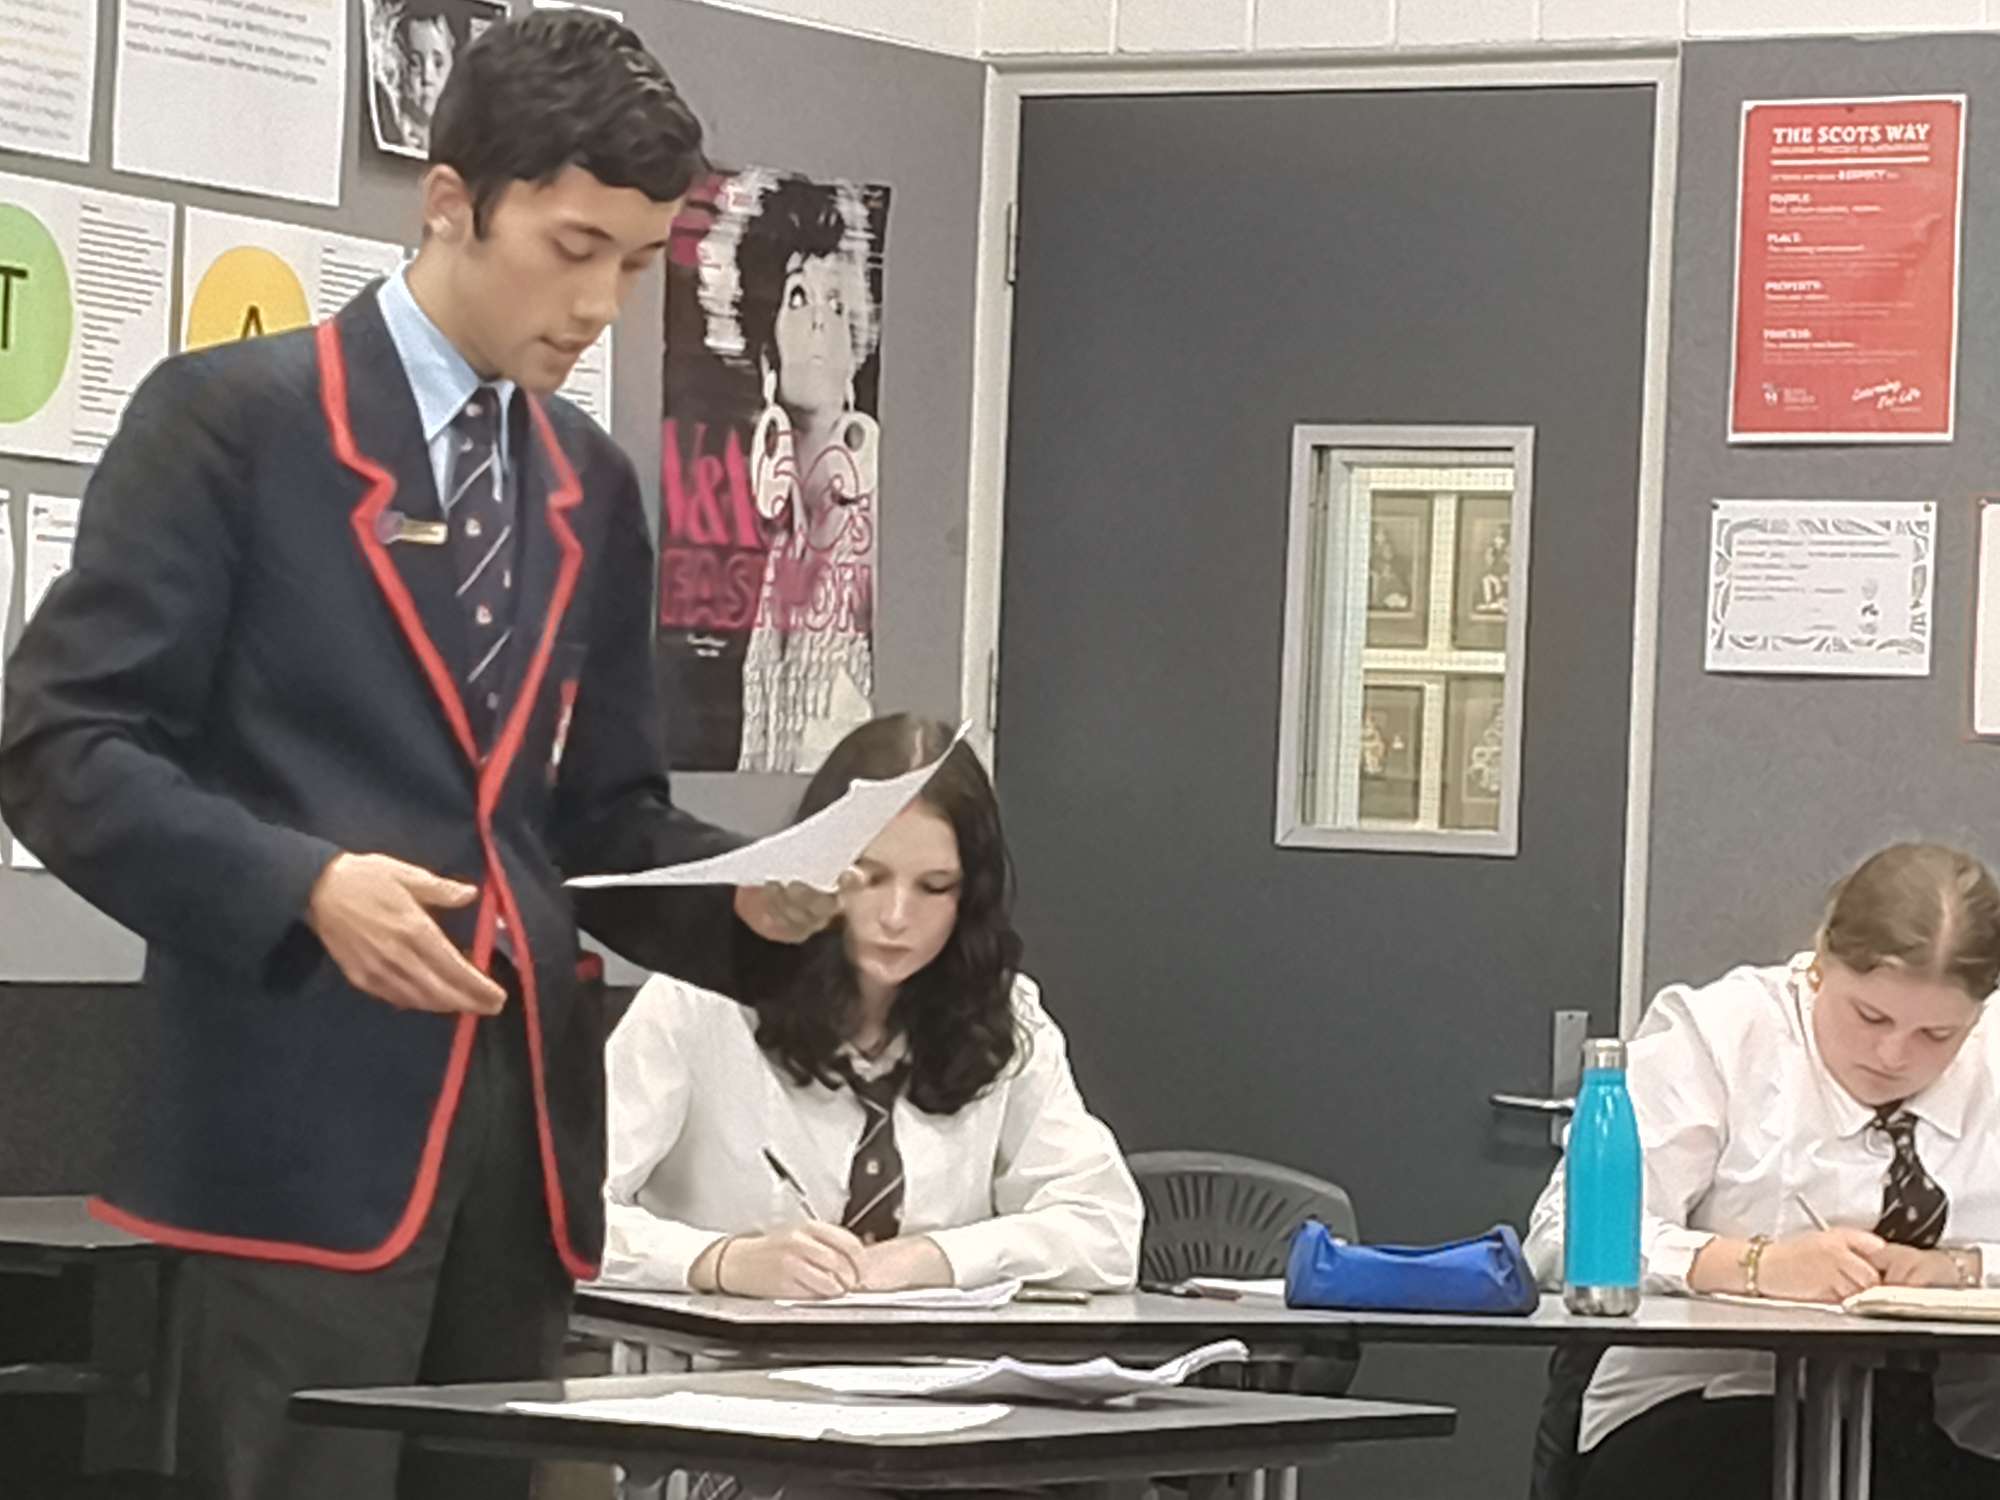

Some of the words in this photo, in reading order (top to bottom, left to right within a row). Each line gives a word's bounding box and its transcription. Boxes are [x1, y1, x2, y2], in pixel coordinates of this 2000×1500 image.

[1773, 127, 1812, 144] THE
[1817, 125, 1881, 144] SCOTS
[1885, 122, 1930, 142] WAY
